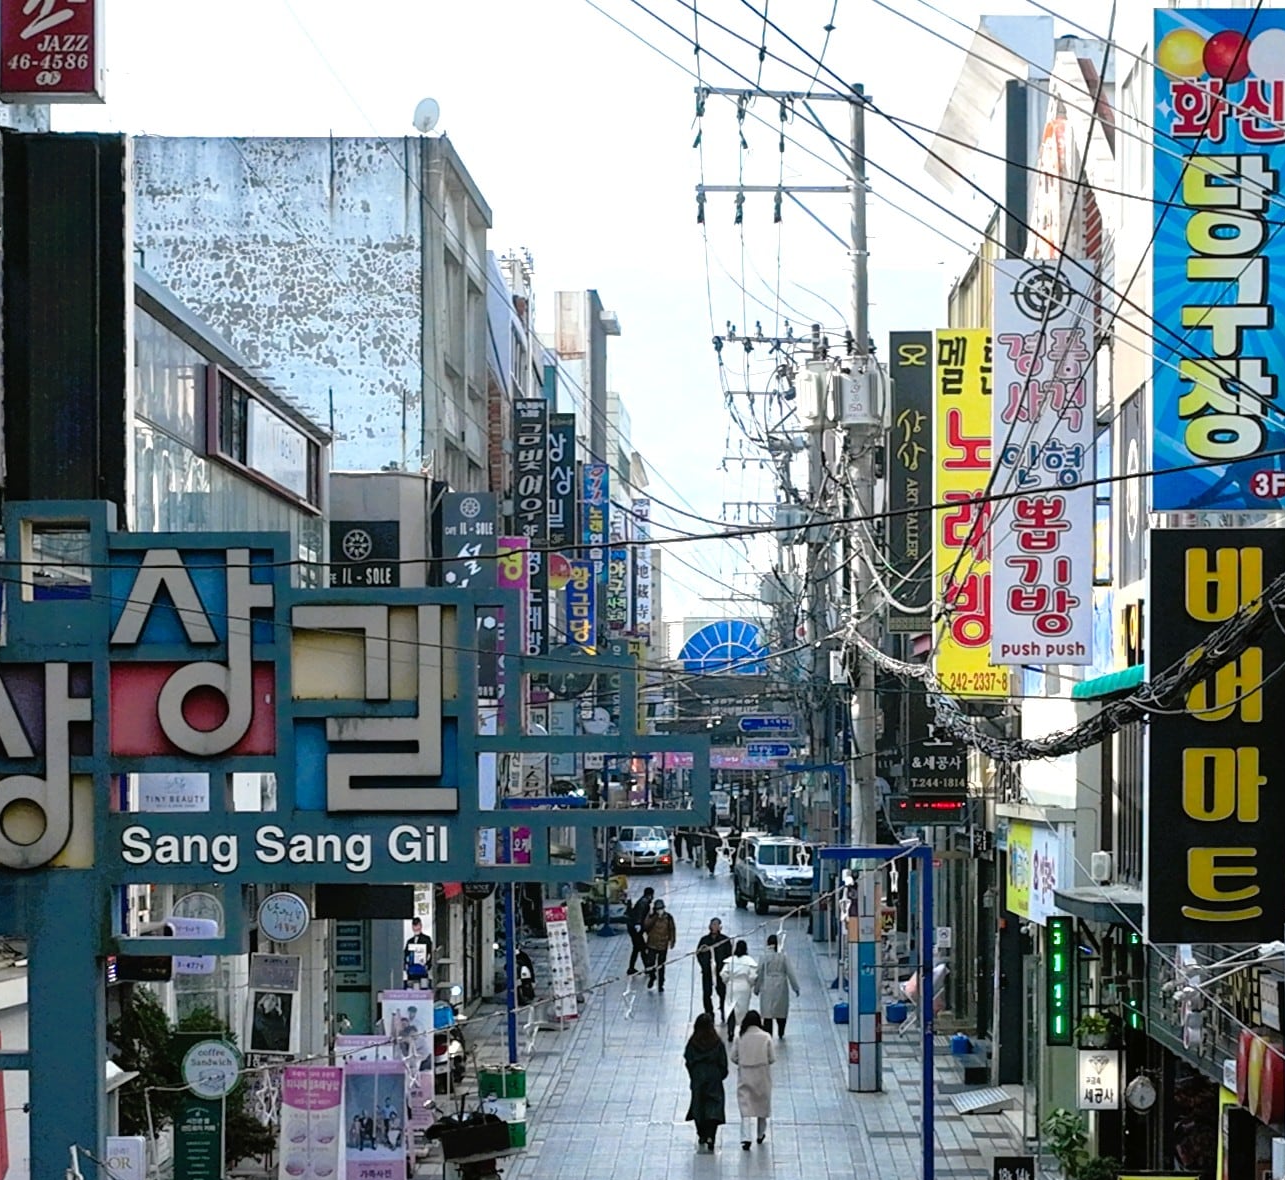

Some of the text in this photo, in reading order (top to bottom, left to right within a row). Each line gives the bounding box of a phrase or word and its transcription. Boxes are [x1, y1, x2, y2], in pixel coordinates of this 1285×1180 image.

[37, 35, 88, 51] JAZZ
[8, 53, 88, 69] 46-4586
[1178, 153, 1279, 461] 당구장
[998, 328, 1091, 380] 경품
[1001, 378, 1087, 432] 사격
[1001, 438, 1085, 489] 인형
[905, 477, 920, 505] ART
[476, 522, 494, 535] SOLE
[522, 524, 539, 536] 3F
[366, 567, 392, 584] SOLE
[570, 566, 593, 643] 황금당
[1001, 642, 1085, 657] push push
[1181, 547, 1268, 922] 비어마트
[122, 824, 450, 873] Sang Sang Gil
[191, 1058, 233, 1067] Sandwich
[197, 1049, 226, 1058] coffee
